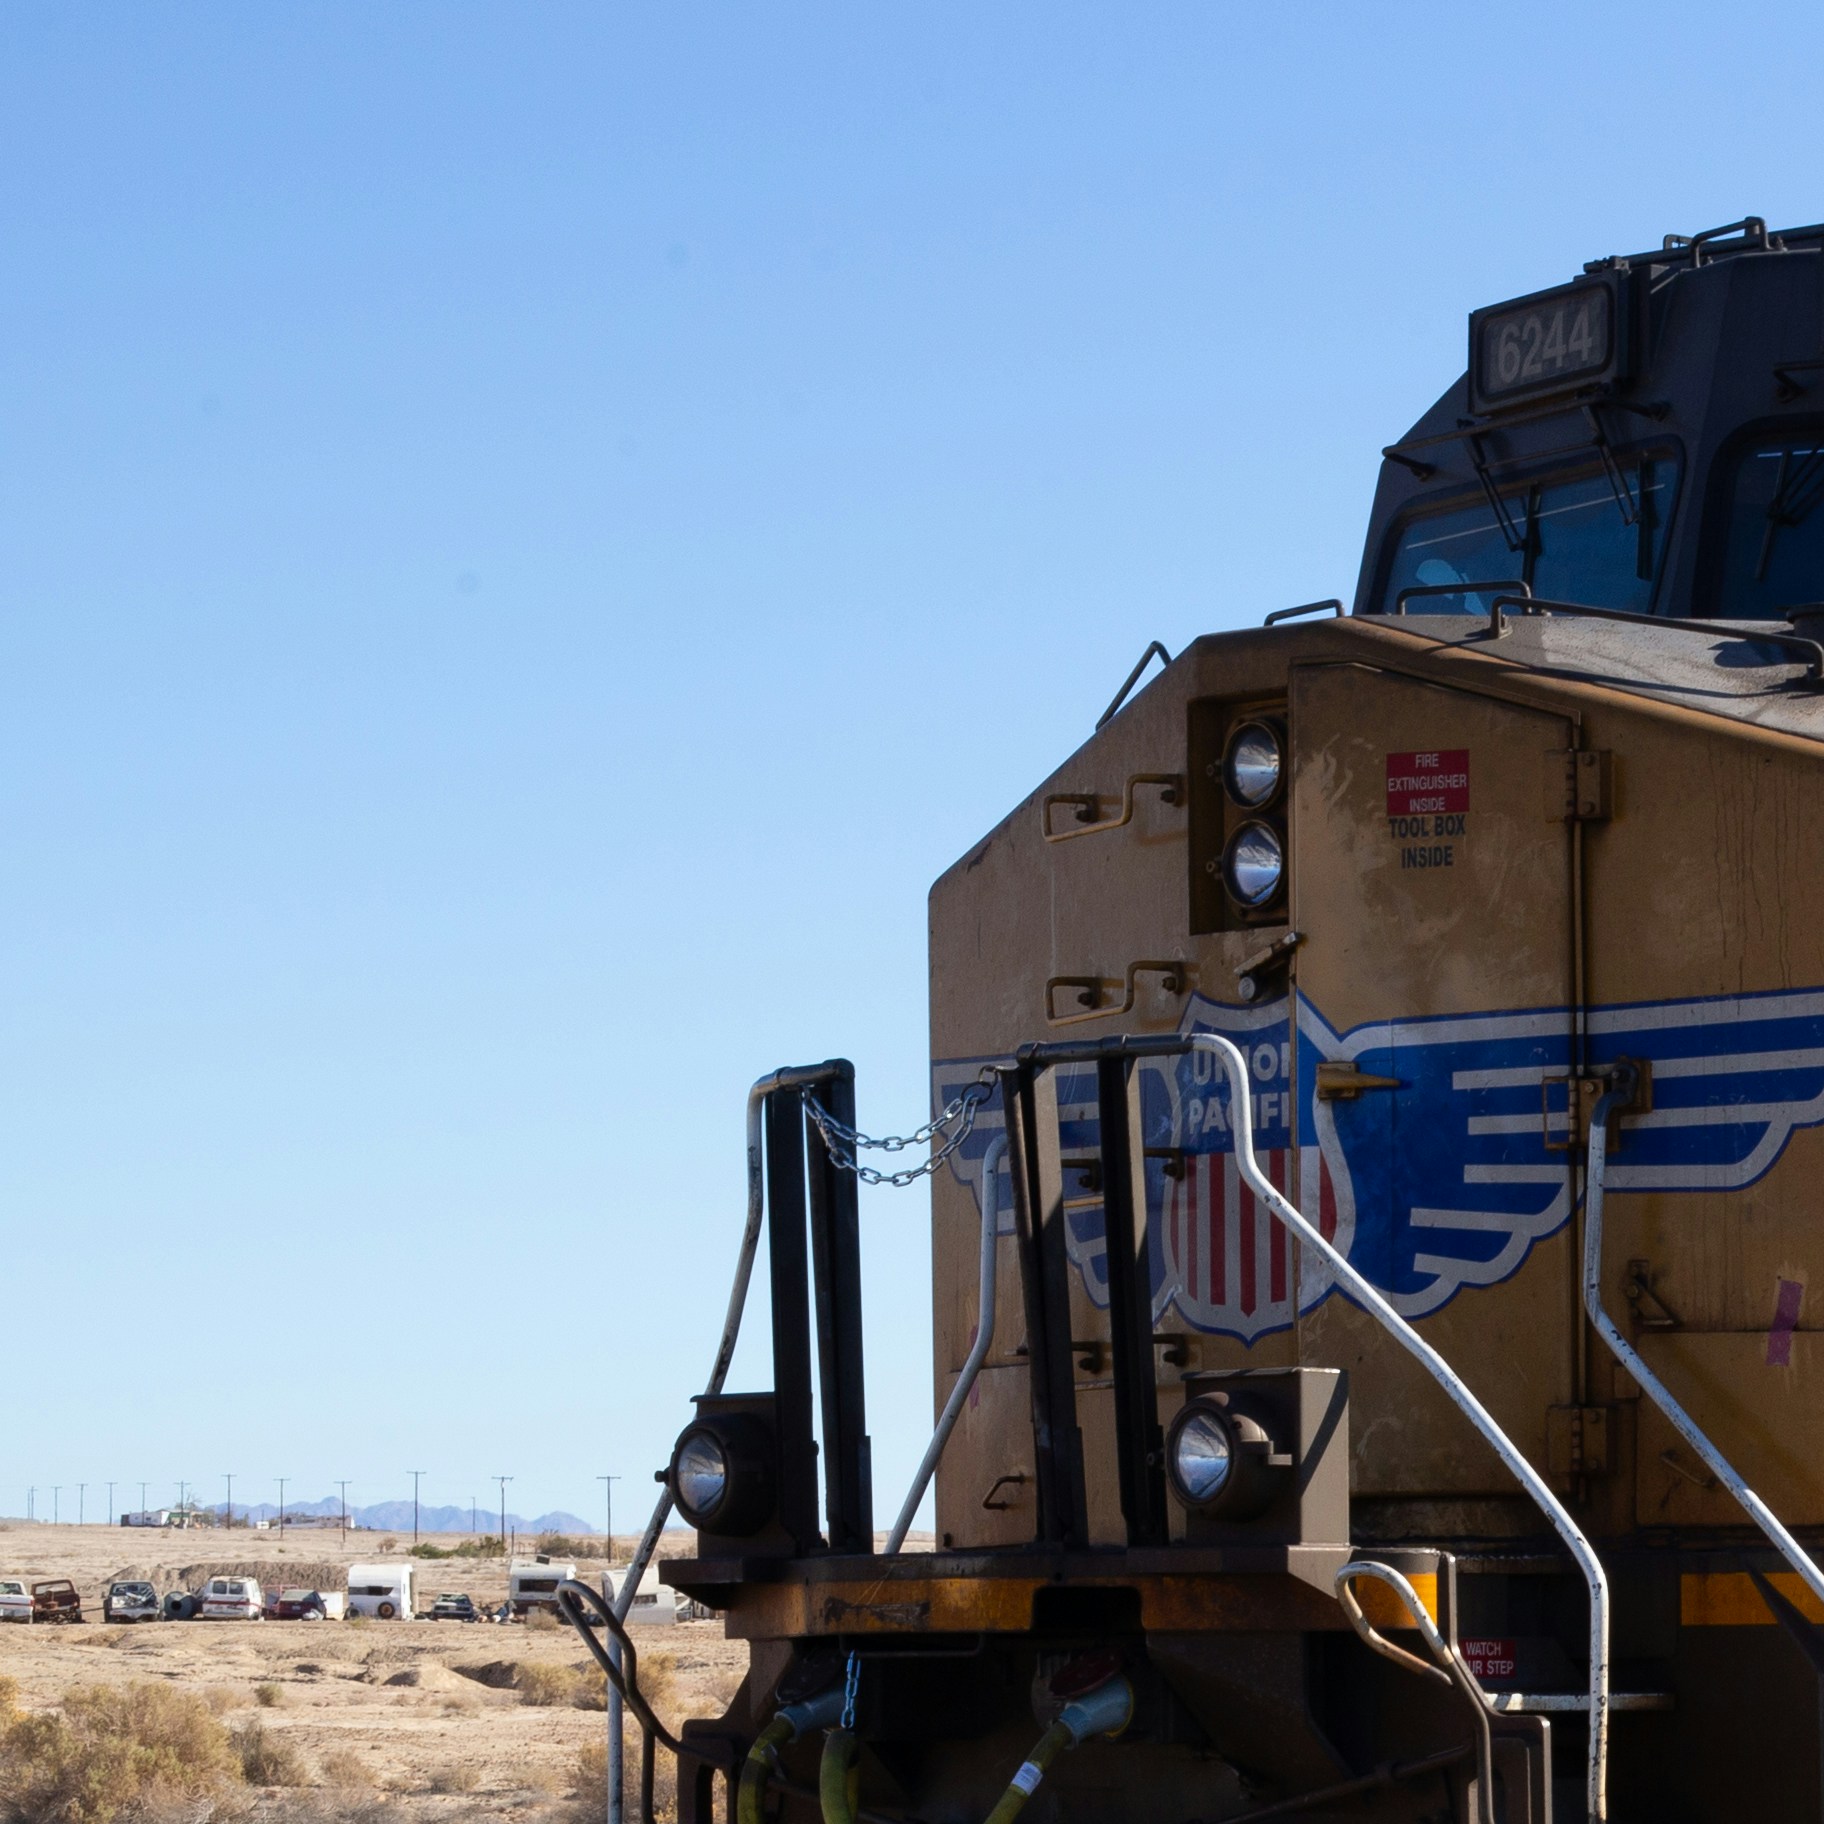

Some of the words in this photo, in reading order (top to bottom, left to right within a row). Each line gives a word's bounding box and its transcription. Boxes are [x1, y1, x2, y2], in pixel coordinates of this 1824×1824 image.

[1497, 304, 1594, 385] 6244
[1415, 753, 1440, 769] FIRE
[1388, 774, 1467, 792] EXTINGUISHER
[1409, 797, 1446, 812] INSIDE
[1389, 817, 1430, 839] TOOL
[1434, 815, 1466, 837] BOX
[1401, 845, 1454, 869] INSIDE
[1465, 1641, 1502, 1657] WATCH
[1468, 1660, 1483, 1674] UR
[1487, 1660, 1514, 1675] STEP
